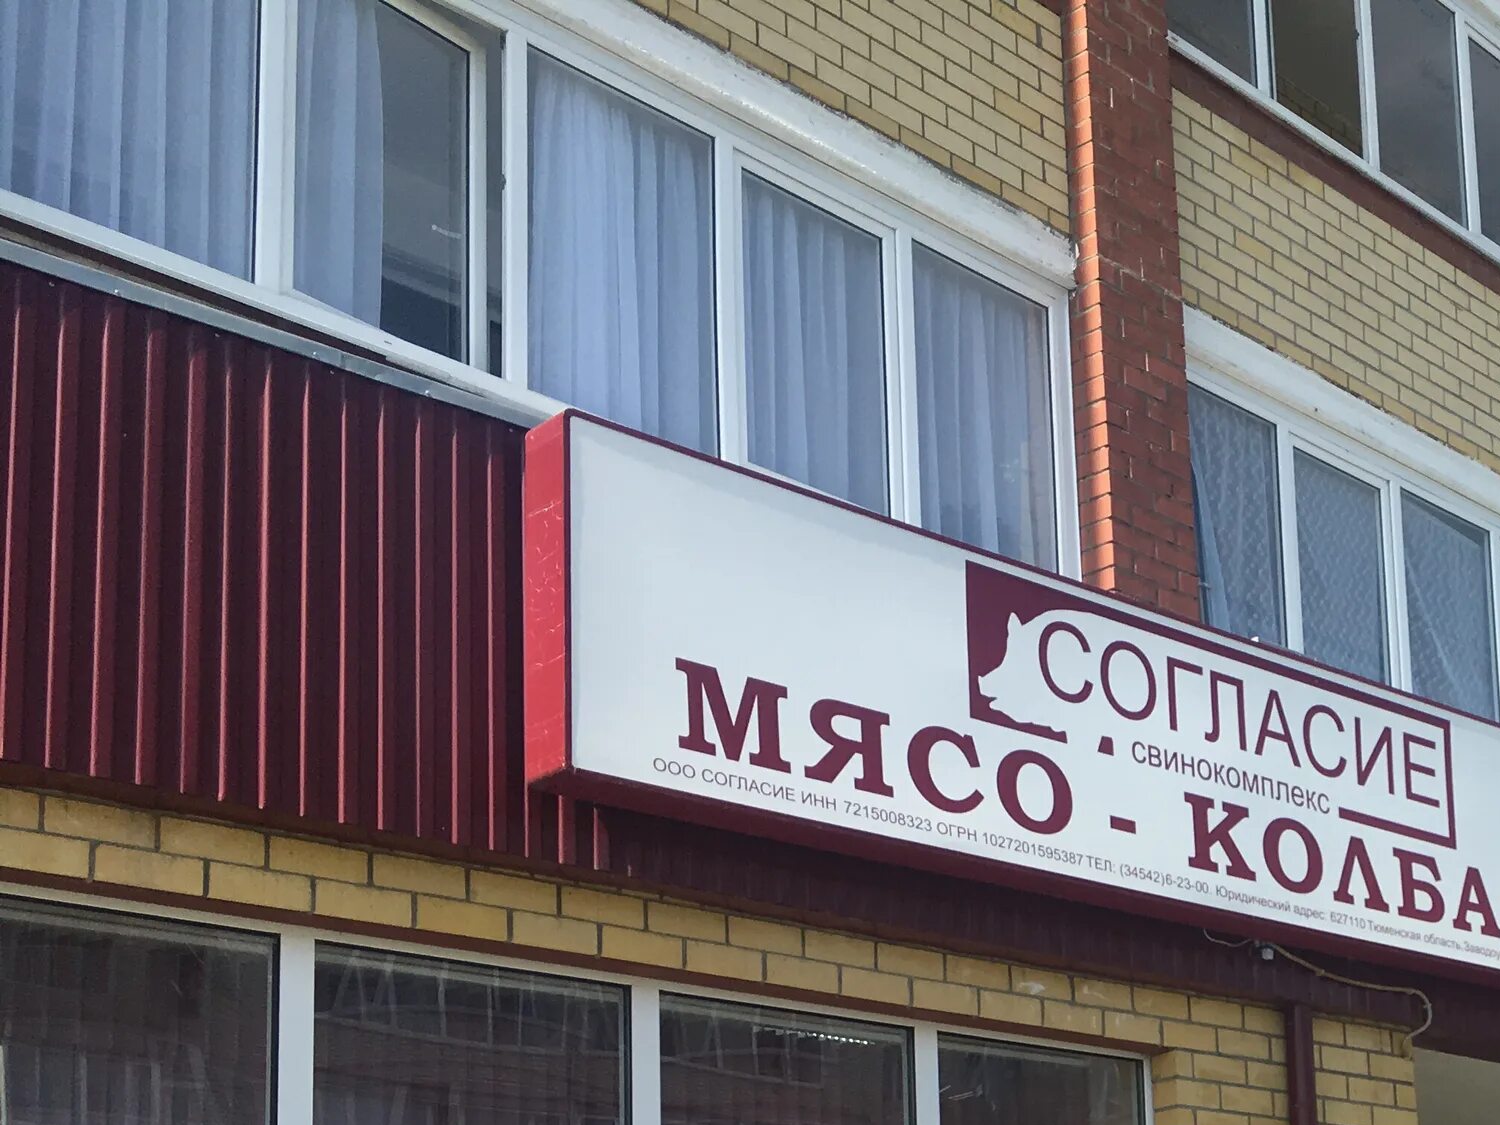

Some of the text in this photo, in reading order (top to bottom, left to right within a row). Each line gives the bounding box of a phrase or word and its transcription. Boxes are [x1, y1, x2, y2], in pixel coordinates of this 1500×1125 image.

[674, 656, 1074, 836] МЯСО
[1037, 620, 1441, 809] СОГЛАСИЕ
[652, 757, 696, 779] ООО
[701, 768, 796, 802] СОГЛАСИЕ
[800, 790, 837, 811] ИНН
[843, 800, 933, 832] 7215008323
[936, 821, 978, 843] ОГРН
[981, 832, 1084, 866] 1027201595387
[1215, 882, 1292, 912] Юридический
[1330, 911, 1366, 930] 627110
[1367, 918, 1422, 941] Тюменская
